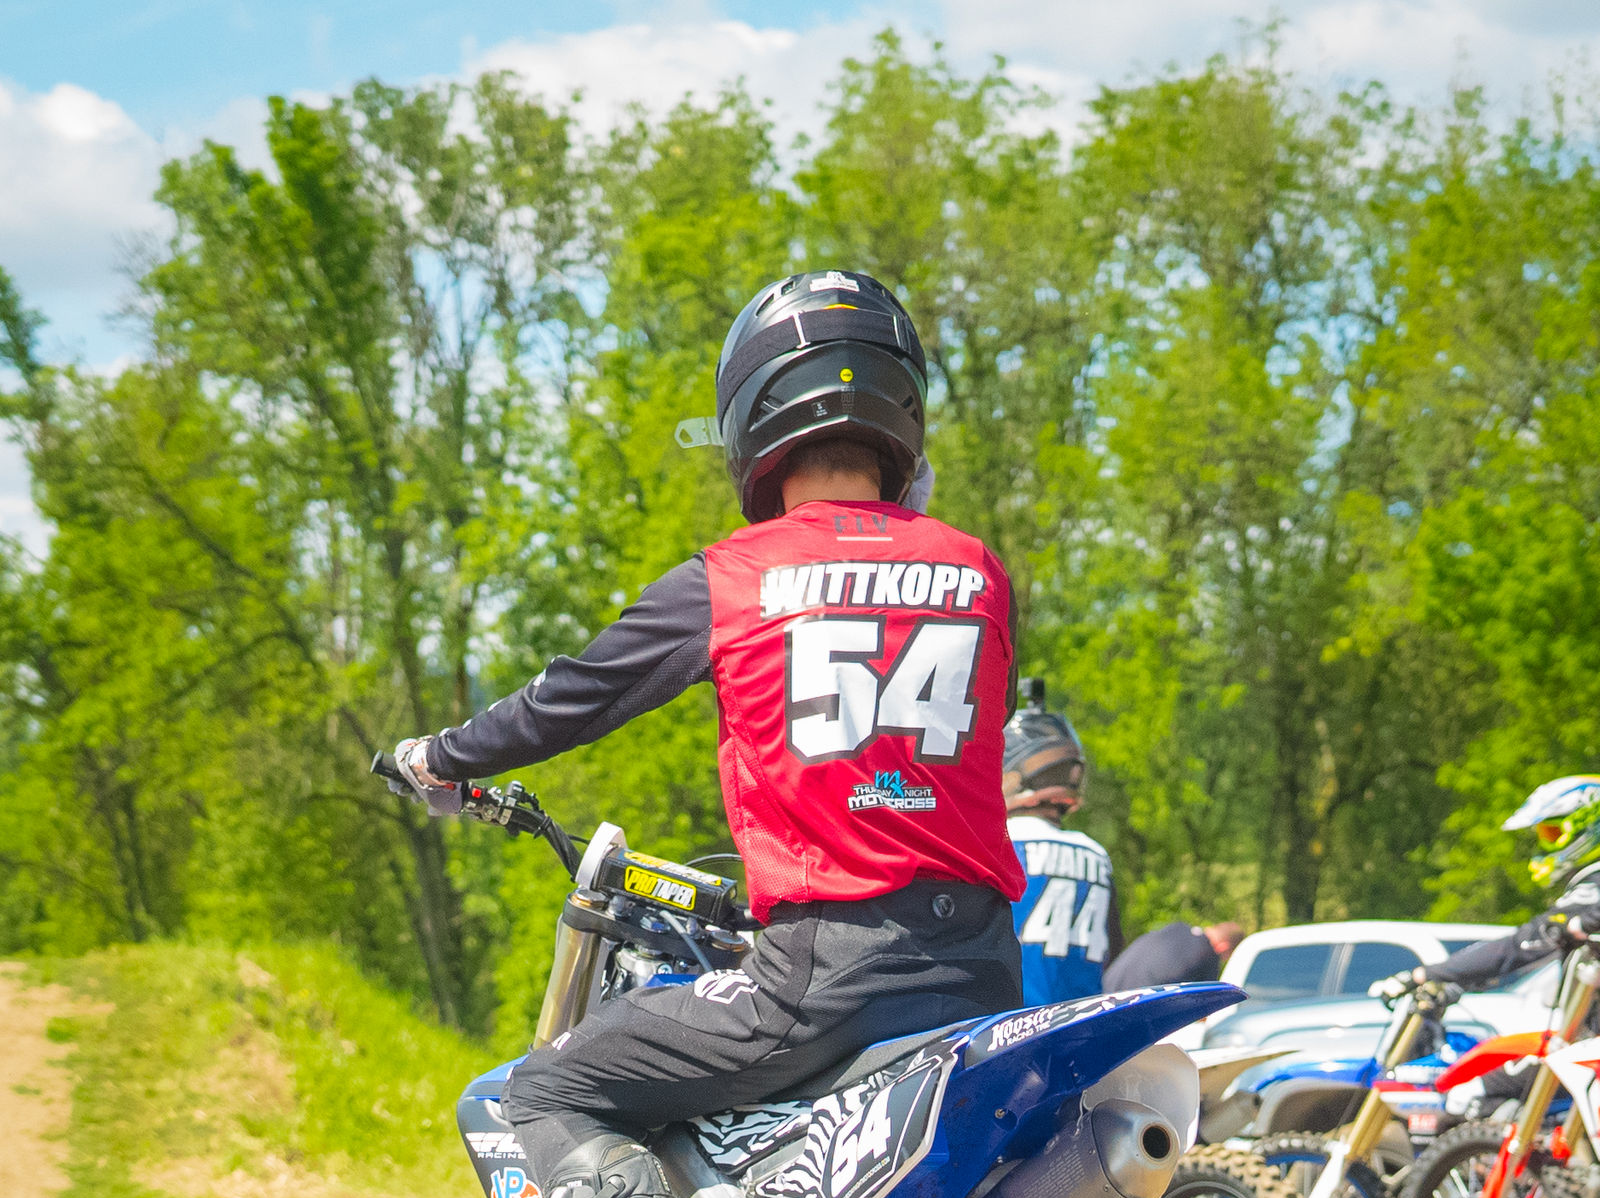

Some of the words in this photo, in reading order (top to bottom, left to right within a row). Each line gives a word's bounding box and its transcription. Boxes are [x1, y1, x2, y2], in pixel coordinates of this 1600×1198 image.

[761, 562, 985, 617] WITTKOPP
[787, 618, 981, 759] 54
[848, 794, 936, 809] MOTCROSS
[853, 786, 892, 798] THUDAY
[904, 789, 932, 797] NIGHT
[1022, 878, 1110, 963] 44
[1007, 1029, 1034, 1047] RACING
[477, 1152, 527, 1160] RACING
[831, 1083, 896, 1198] 54
